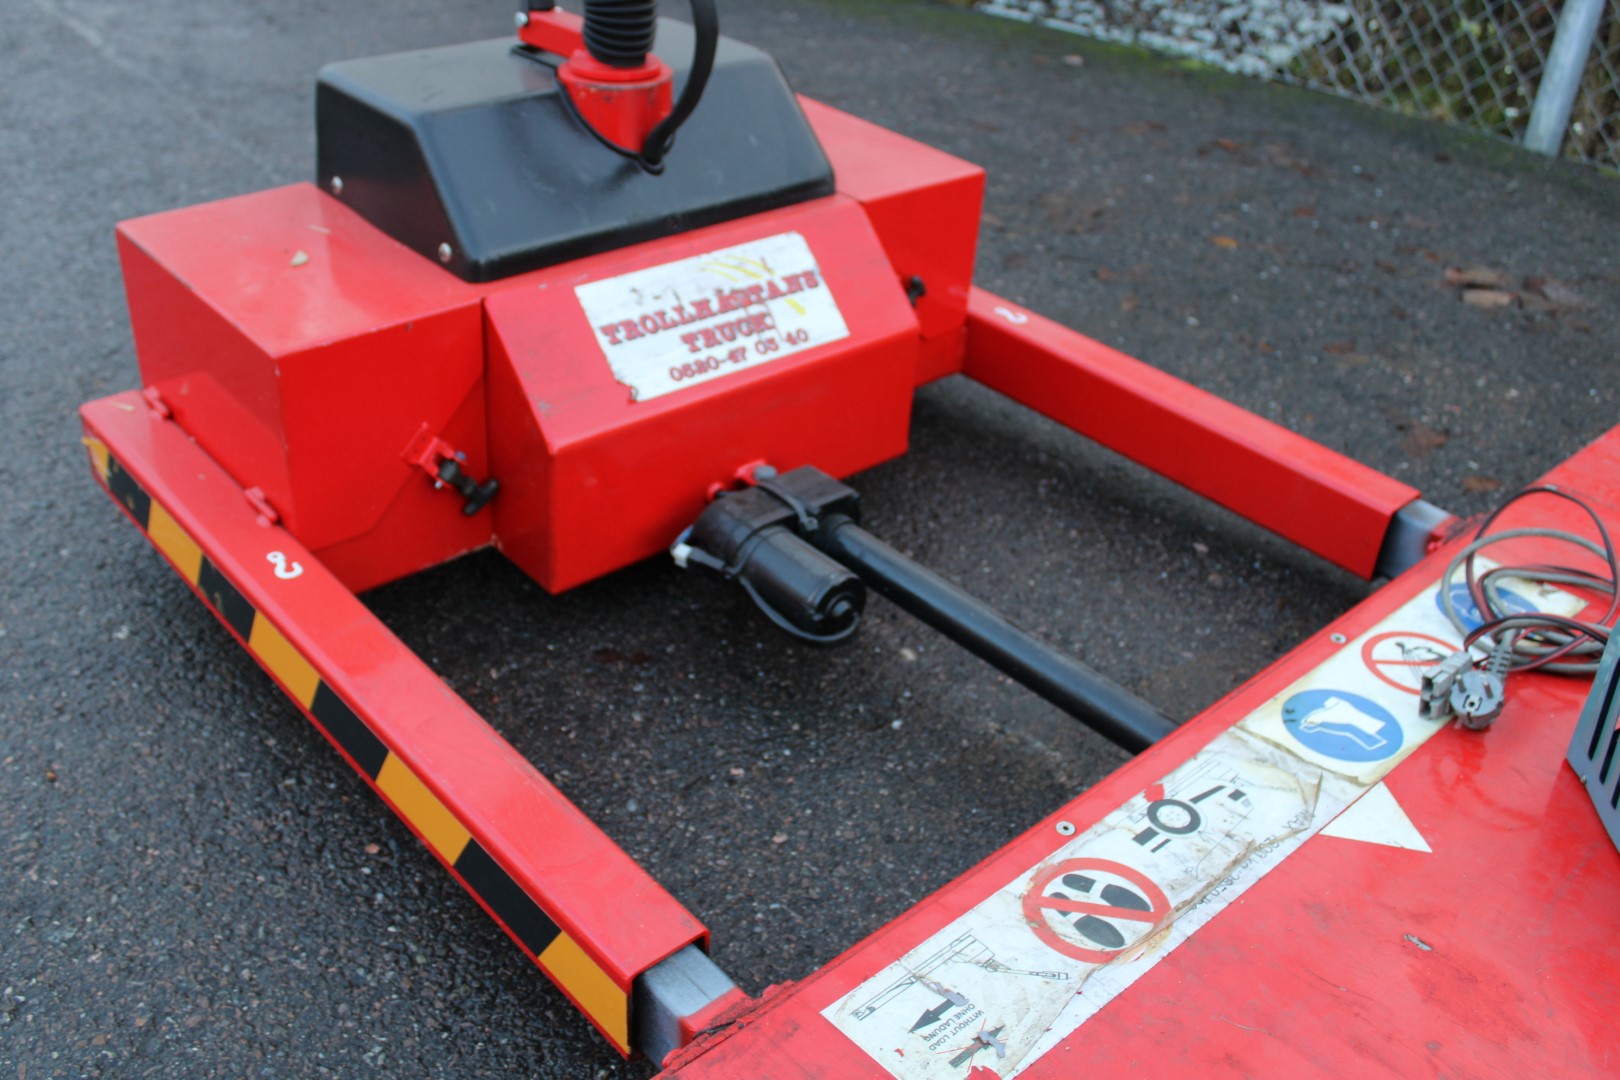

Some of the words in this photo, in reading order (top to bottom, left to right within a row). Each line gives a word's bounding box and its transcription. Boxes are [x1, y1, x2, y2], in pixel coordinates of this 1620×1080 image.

[680, 312, 776, 353] TRUCK
[950, 1009, 985, 1037] WITHOUT
[952, 1003, 976, 1021] OHNE
[925, 1017, 953, 1043] LADUNG
[928, 1034, 951, 1052] LOAD
